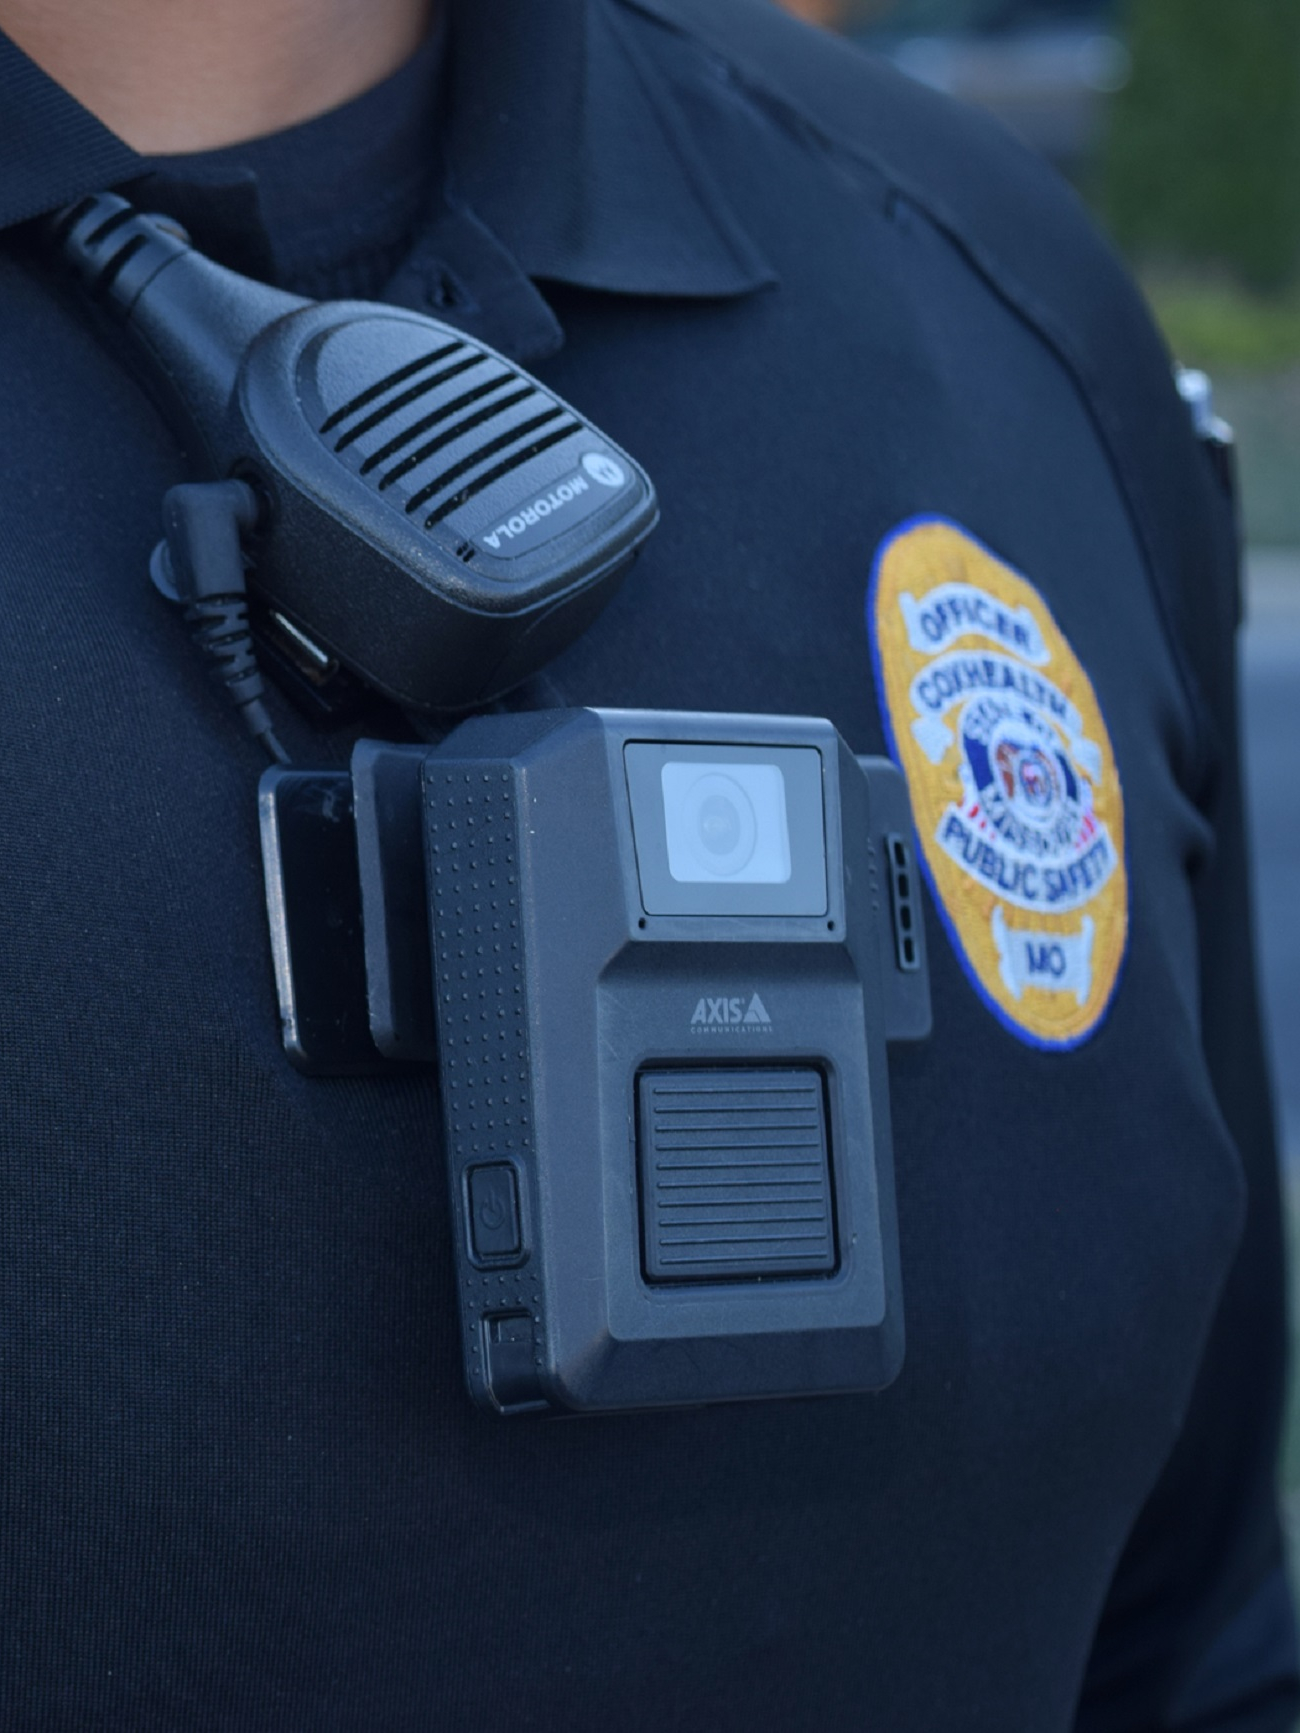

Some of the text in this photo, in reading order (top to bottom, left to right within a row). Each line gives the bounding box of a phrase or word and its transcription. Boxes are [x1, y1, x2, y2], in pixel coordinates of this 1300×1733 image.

[482, 474, 589, 549] MOTOROLA
[919, 597, 1030, 649] OFFICER
[944, 814, 1037, 900] PUBLIC
[1043, 836, 1109, 904] SAFETY
[1024, 940, 1068, 977] MO
[690, 997, 743, 1025] AXIS
[690, 1025, 773, 1035] COMMUNICATIONS
